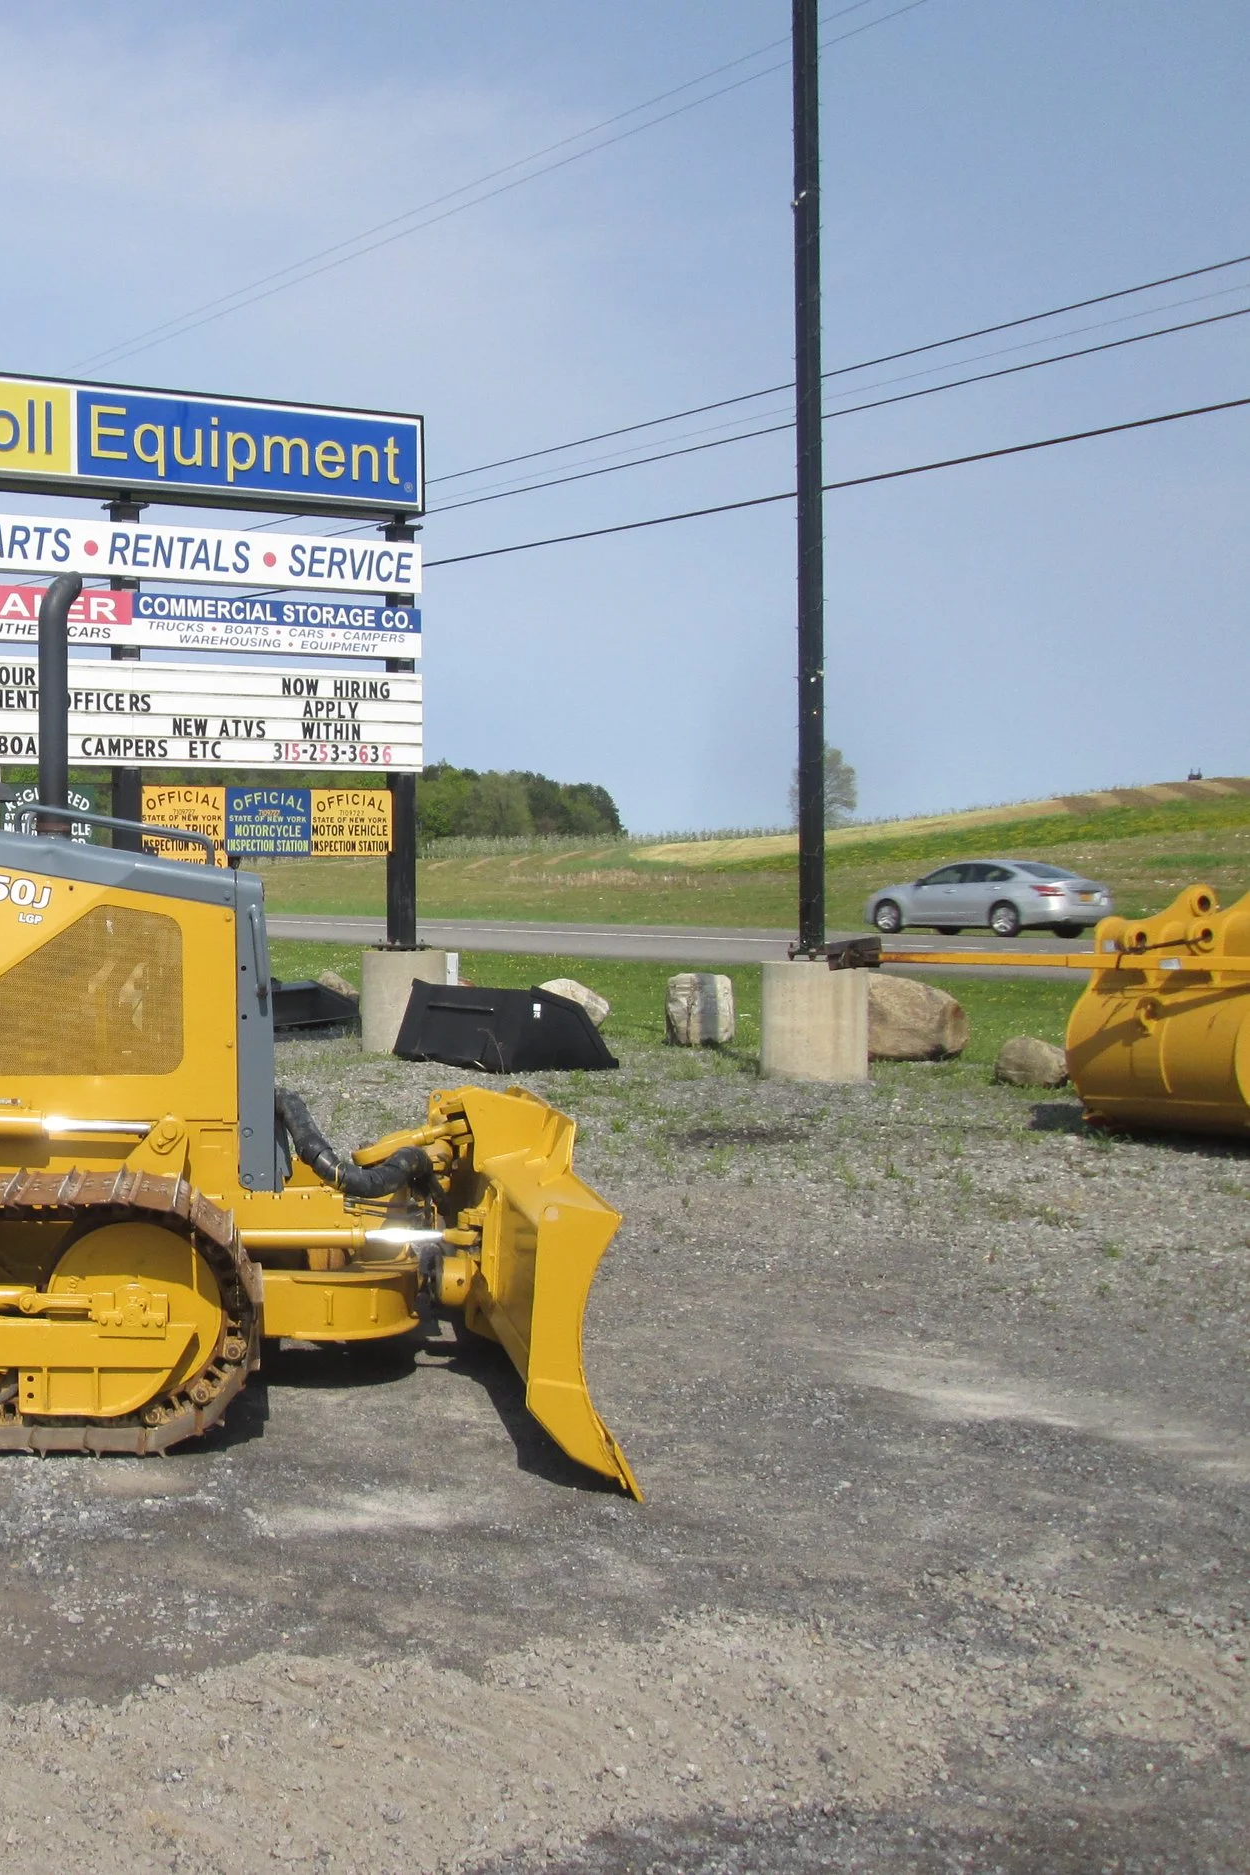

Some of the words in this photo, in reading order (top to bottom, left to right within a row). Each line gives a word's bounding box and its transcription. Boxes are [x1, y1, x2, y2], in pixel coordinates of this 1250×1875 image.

[91, 405, 399, 484] Equipment
[108, 532, 251, 573] RENTALS
[288, 544, 413, 583] SERVICE
[139, 596, 277, 621] COMMERCIAL
[283, 604, 375, 627] STORAGE
[381, 610, 413, 629] CO.
[67, 626, 111, 639] CARS
[148, 621, 204, 632] TRUCKS
[224, 625, 269, 636] BOATS
[288, 628, 324, 639] CARS
[343, 631, 405, 643] CAMPERS
[179, 634, 281, 648] WAREHOUSING
[301, 640, 378, 653] EQUIPMENT
[282, 677, 318, 696] NOW
[334, 680, 390, 699] HIRING
[303, 700, 359, 719] APPLY
[172, 718, 208, 737] NEW
[219, 719, 266, 738] ATVS
[302, 722, 361, 741] WITHIN
[81, 737, 168, 757] CAMPERS
[189, 741, 221, 759] ETC
[273, 742, 392, 764] 315-253-3636
[5, 787, 90, 811] REGIRED
[146, 790, 220, 810] OFFICIAL
[233, 792, 304, 812] OFFICIAL
[316, 793, 385, 813] OFFICIAL
[235, 825, 301, 837] MOTORCYCLE
[312, 825, 344, 836] MOTOR
[348, 825, 388, 836] VEHICLE
[143, 839, 189, 851] NSPECTION
[192, 839, 225, 851] STAON
[227, 839, 274, 851] INSPECTION
[276, 840, 308, 852] STATION
[311, 840, 356, 852] INSPECTION
[358, 841, 389, 852] STATION
[18, 912, 43, 925] LGP
